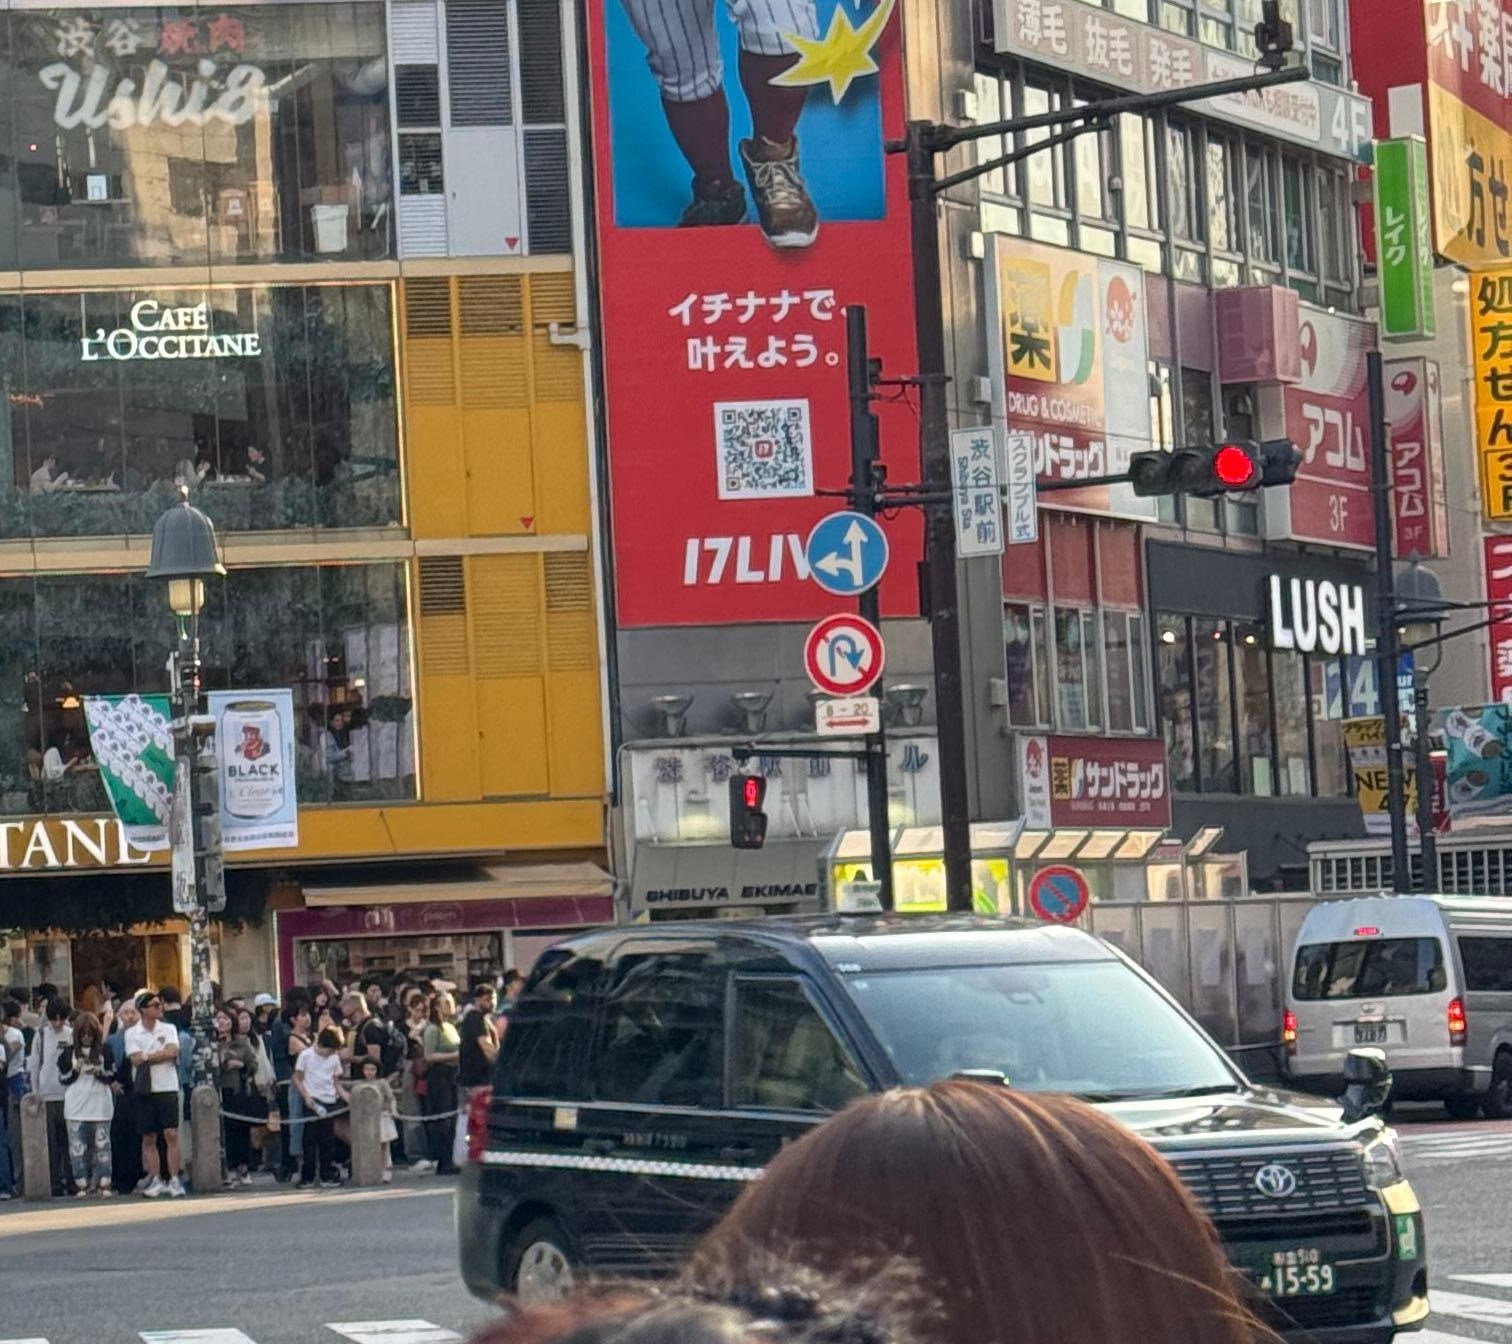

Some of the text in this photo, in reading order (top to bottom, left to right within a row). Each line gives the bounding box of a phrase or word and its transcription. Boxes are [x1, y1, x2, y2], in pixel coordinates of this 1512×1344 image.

[1331, 95, 1369, 157] 4F
[688, 334, 840, 372] 叶えよう。
[1007, 391, 1039, 417] DRUG
[1303, 402, 1366, 472] アコム
[970, 438, 997, 544] 渋谷駅前
[1011, 437, 1031, 538] スクランブル式
[1395, 441, 1425, 519] アコム
[1328, 493, 1349, 533] 3F
[683, 532, 814, 586] 17LIV
[1268, 573, 1366, 656] LUSH
[227, 763, 280, 778] BLACK
[1085, 760, 1164, 800] サンドラッグ
[646, 882, 818, 903] SHIBUYA EKIMAE
[1275, 1264, 1334, 1296] 15-59
